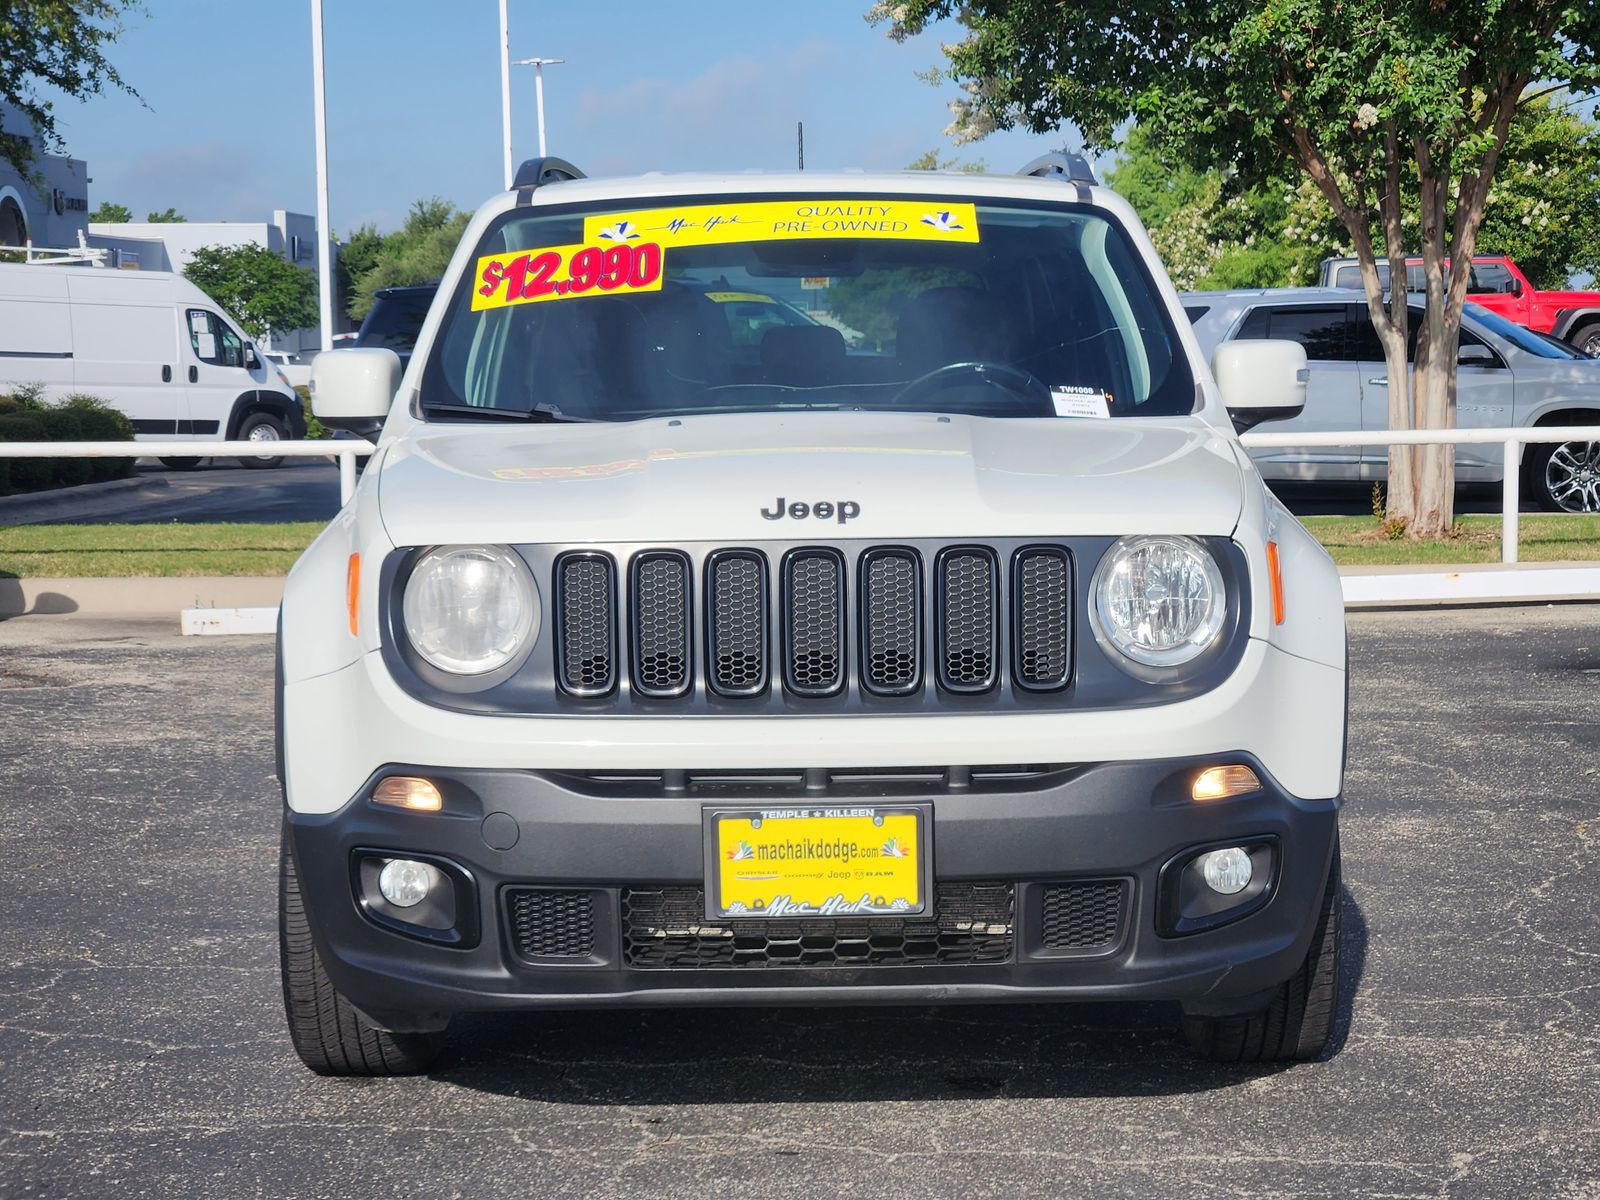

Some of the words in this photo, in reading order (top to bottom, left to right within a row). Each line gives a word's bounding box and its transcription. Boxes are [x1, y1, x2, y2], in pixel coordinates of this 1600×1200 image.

[796, 206, 892, 217] QUALITY
[772, 220, 909, 232] PRE-OWNED
[760, 497, 861, 524] Jeep
[760, 809, 810, 819] TEMPLE
[824, 808, 876, 818] KILLEEN
[757, 837, 879, 863] machaikdodge.com
[827, 870, 851, 880] Jeep
[764, 894, 819, 917] Mac
[818, 892, 878, 916] Haik
